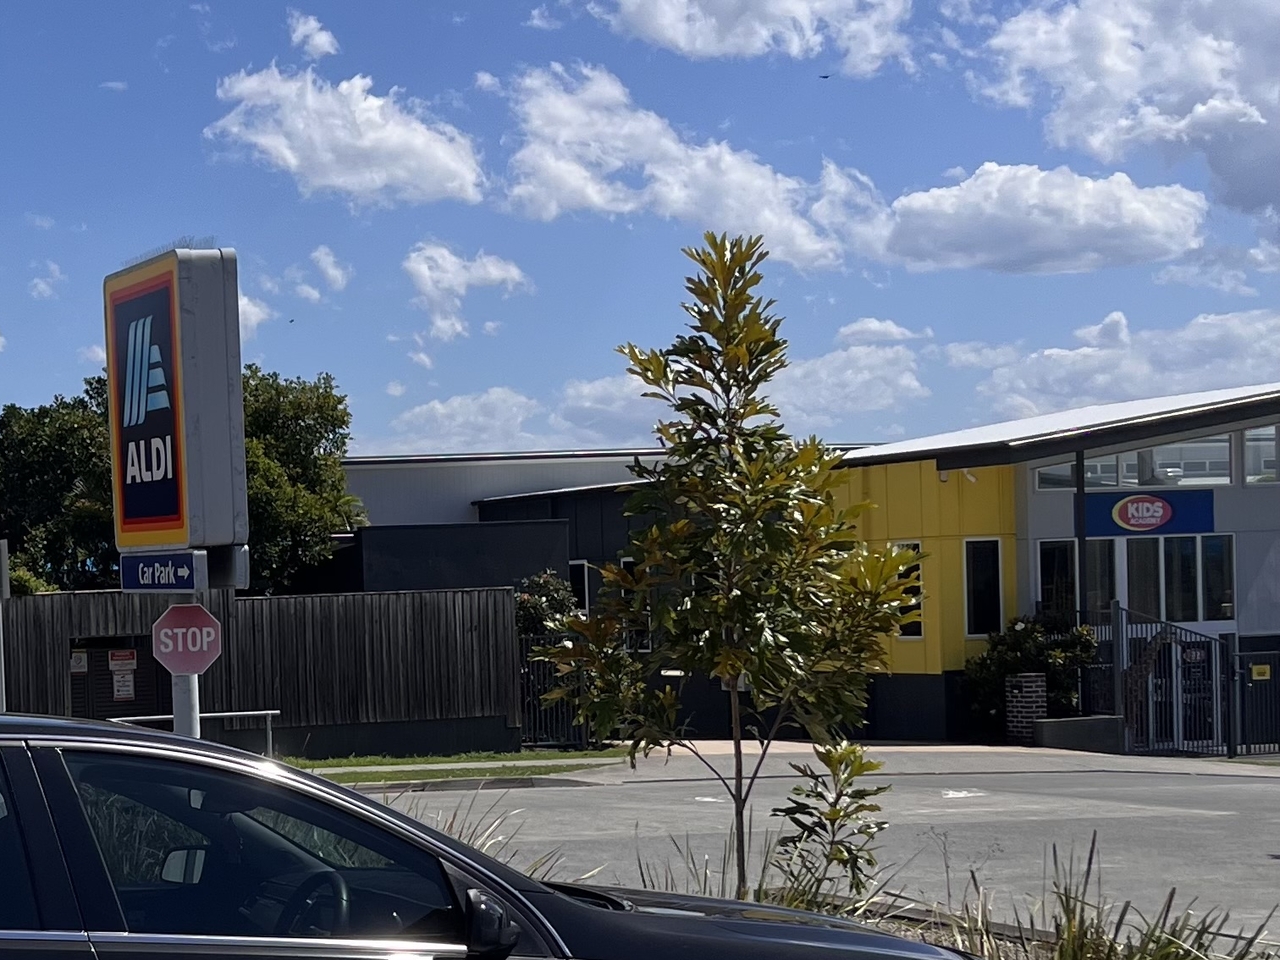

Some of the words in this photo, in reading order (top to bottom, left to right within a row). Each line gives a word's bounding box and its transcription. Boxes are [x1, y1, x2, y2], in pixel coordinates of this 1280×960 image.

[126, 434, 173, 484] ALDI
[1127, 501, 1164, 518] KIDS
[138, 562, 153, 585] Car
[154, 560, 176, 585] Park
[159, 627, 216, 653] STOP
